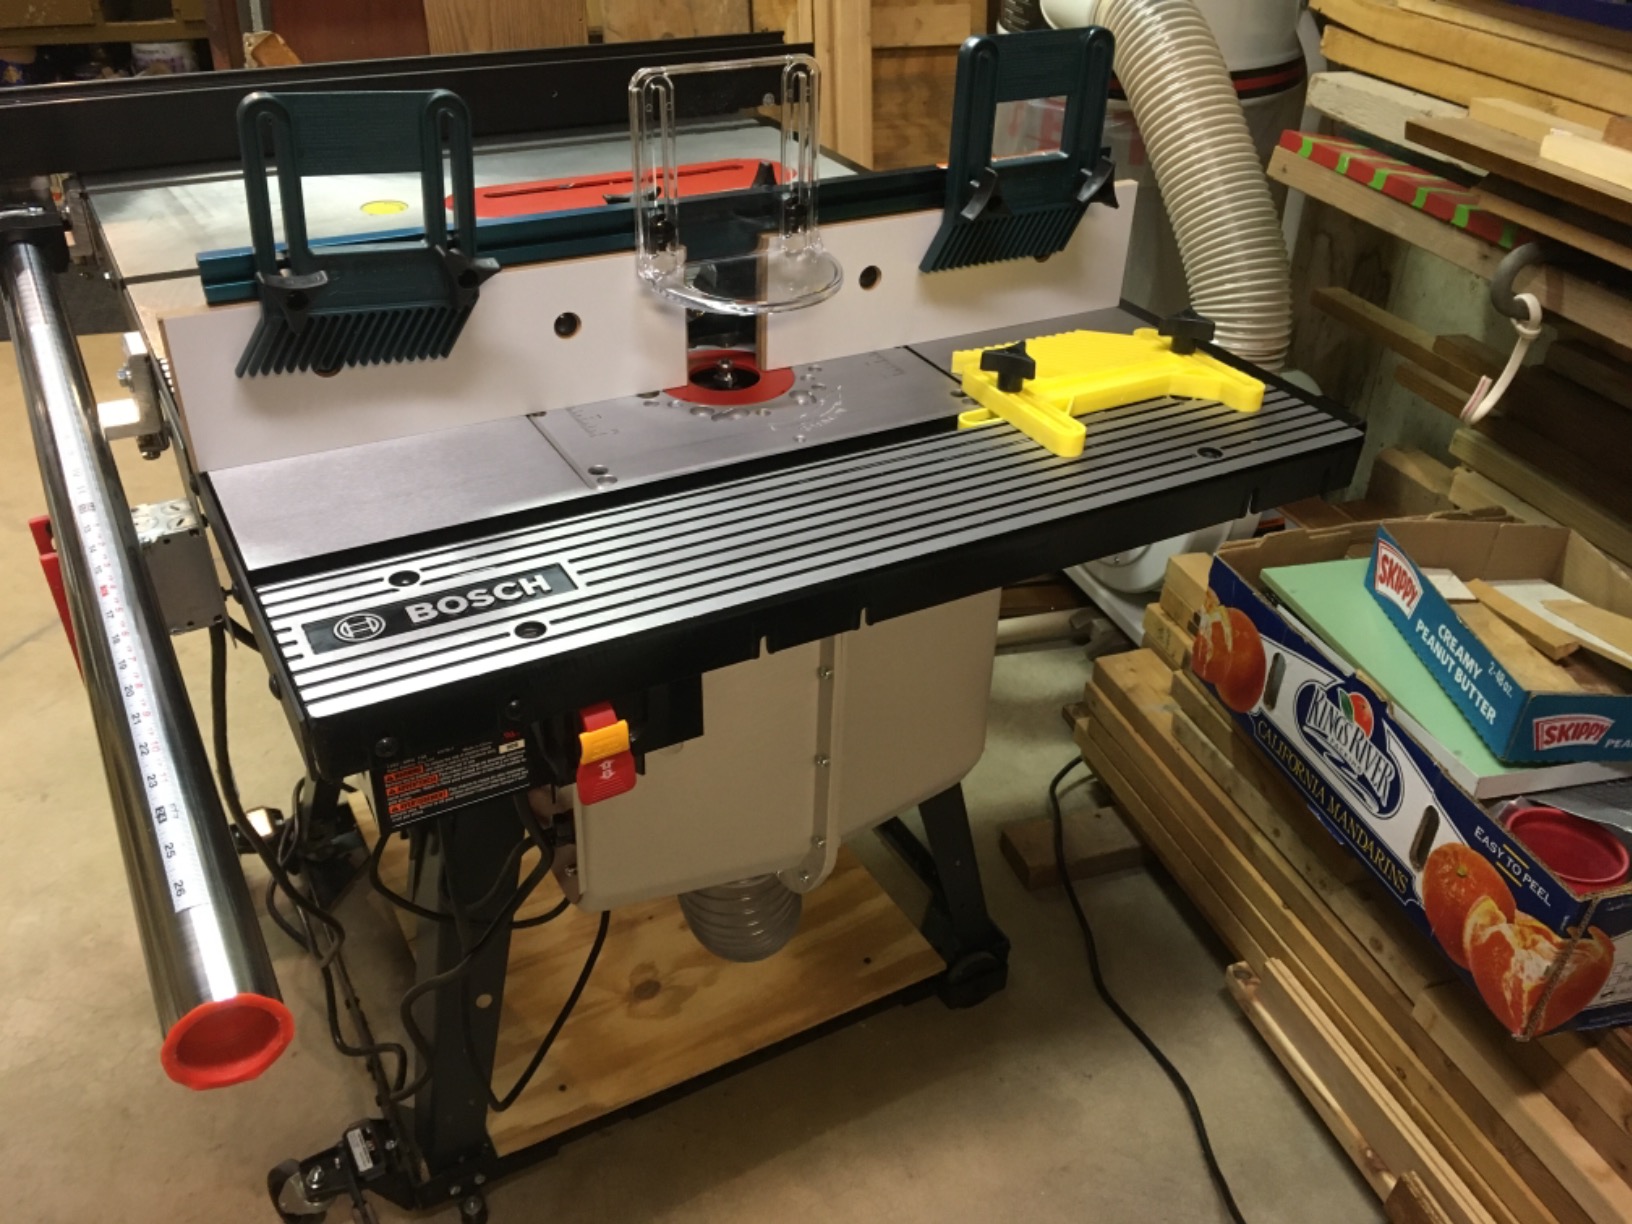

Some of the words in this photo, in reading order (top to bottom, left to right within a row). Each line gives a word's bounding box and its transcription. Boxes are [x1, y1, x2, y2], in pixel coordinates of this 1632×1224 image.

[404, 573, 552, 624] BOSCH
[1378, 554, 1417, 608] SKIPPY
[1415, 618, 1456, 674] PEANUT
[1438, 624, 1483, 680] CREAMY
[1454, 668, 1497, 725] BUTTER
[1305, 688, 1349, 746] KINGS
[1349, 727, 1395, 806] RIVER
[1543, 722, 1610, 746] SKIPPY
[118, 659, 127, 670] 19
[124, 685, 135, 698] 20
[131, 712, 142, 725] 21
[138, 742, 150, 756] 22
[147, 773, 158, 789] 23
[165, 842, 176, 859] 25
[173, 880, 186, 897] 26
[1256, 719, 1326, 804] CALIFORNIA
[1326, 796, 1409, 895] MANDARINS
[1473, 825, 1504, 860] EASY
[1506, 855, 1522, 877] TO
[1522, 873, 1552, 908] PEEL
